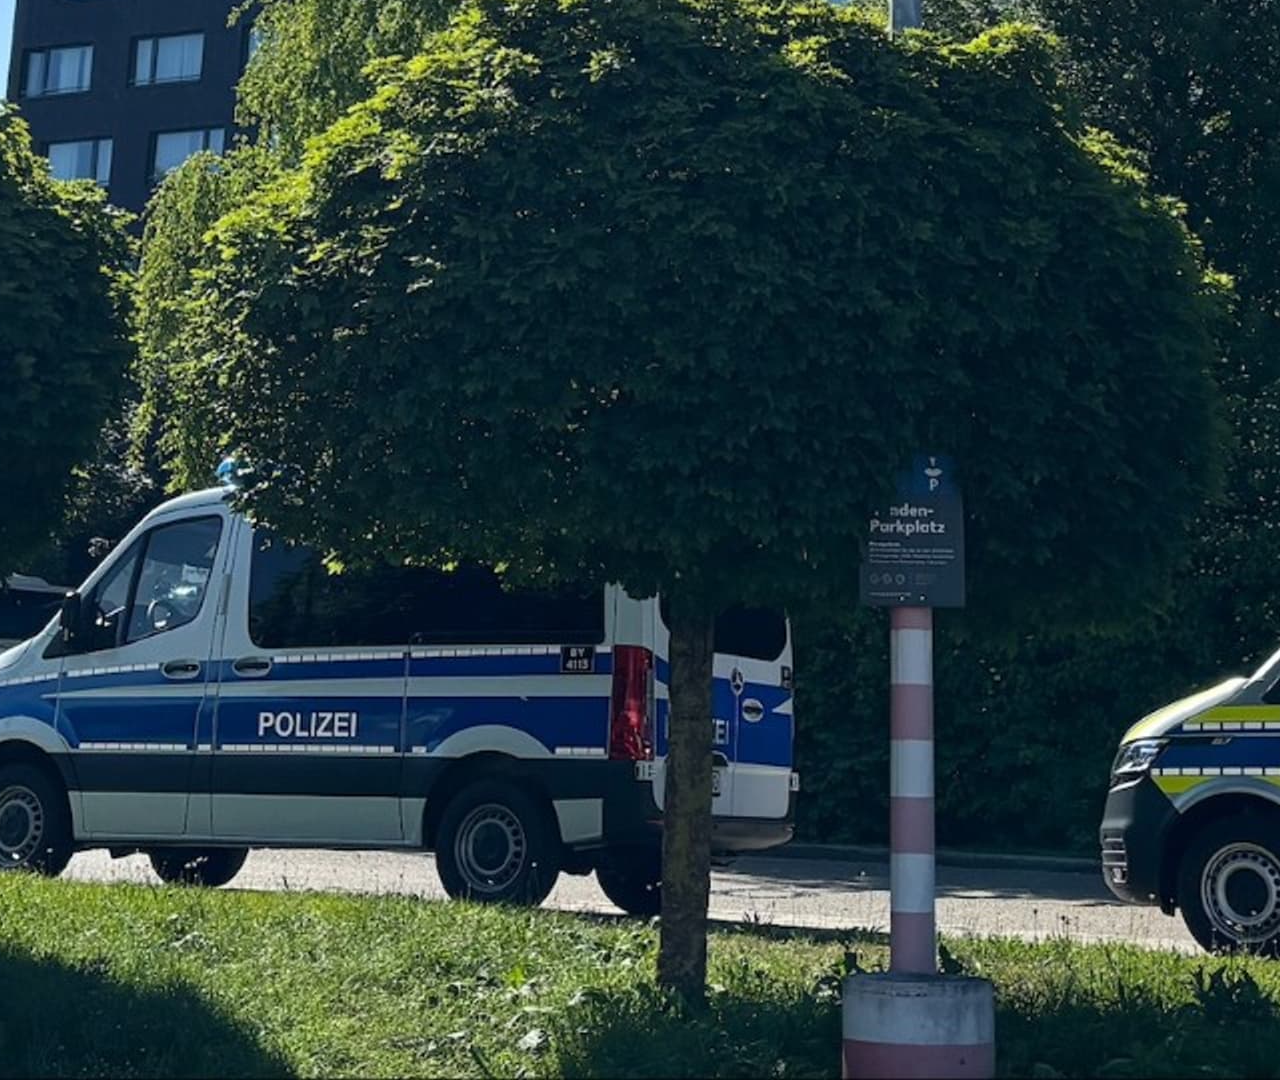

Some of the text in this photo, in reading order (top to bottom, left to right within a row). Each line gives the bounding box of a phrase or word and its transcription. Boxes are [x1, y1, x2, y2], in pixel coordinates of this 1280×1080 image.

[873, 503, 935, 518] nden-
[869, 520, 946, 536] Parkplatz
[258, 712, 357, 737] POLIZEI
